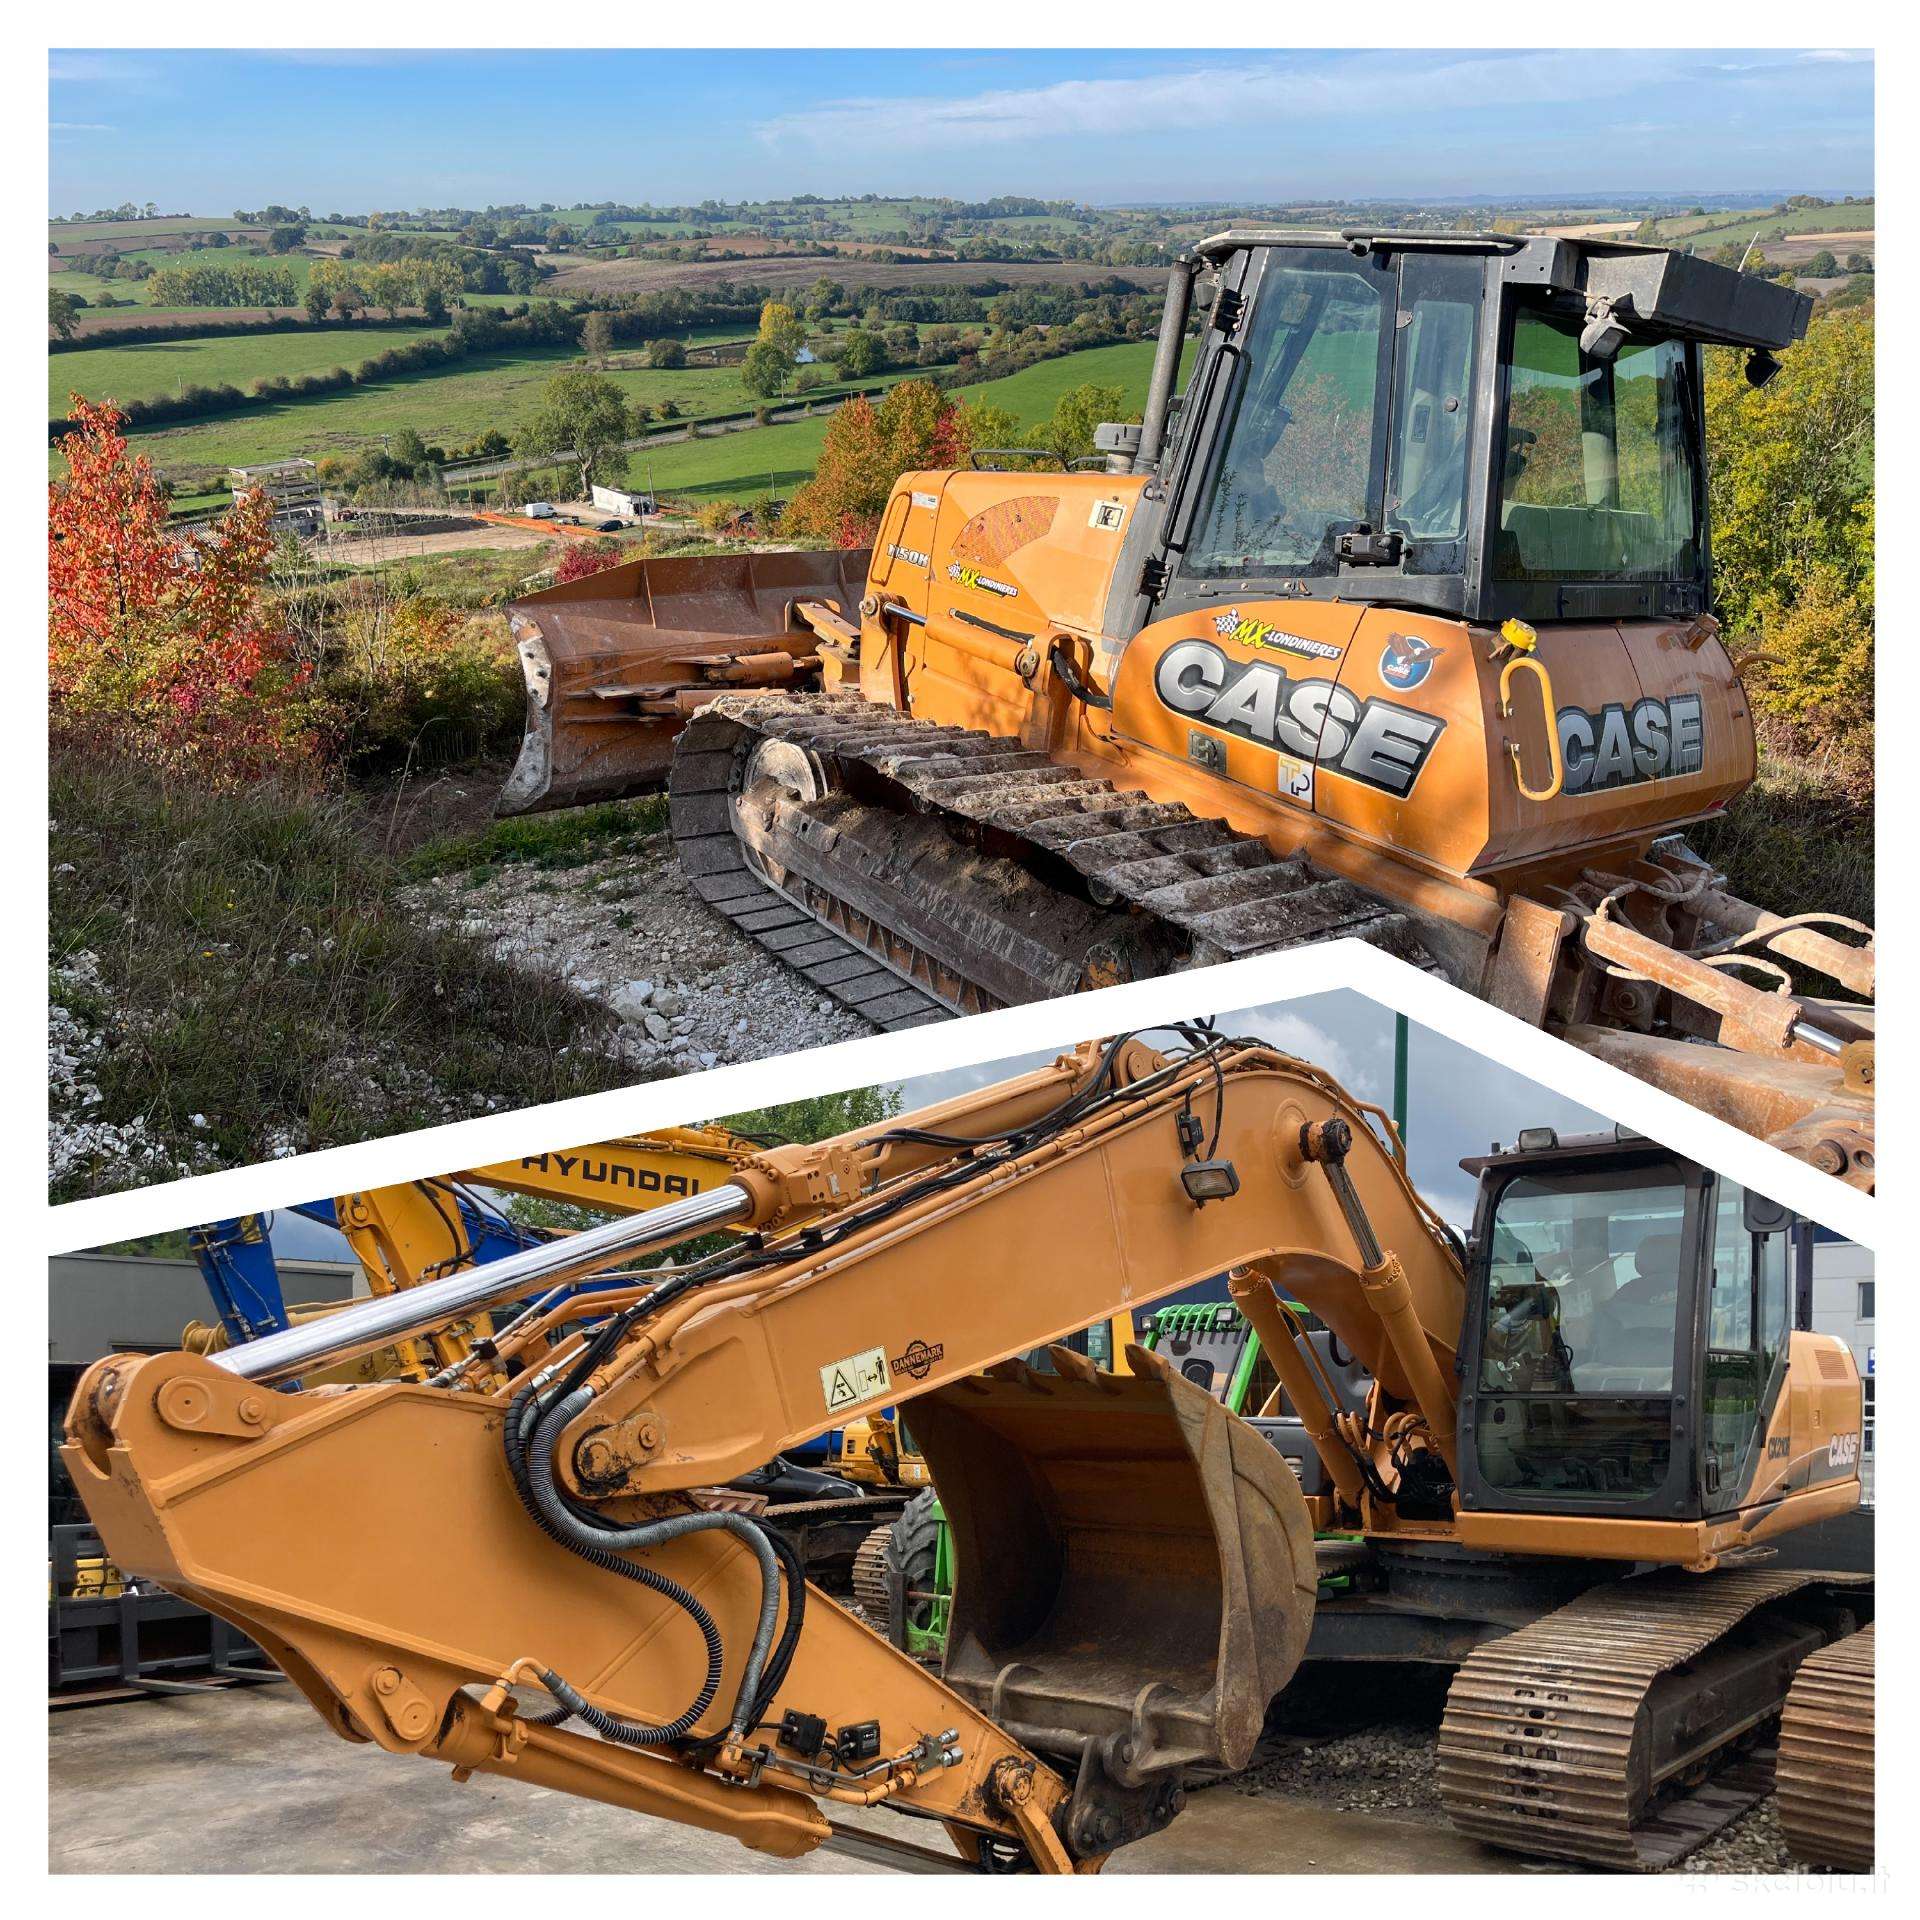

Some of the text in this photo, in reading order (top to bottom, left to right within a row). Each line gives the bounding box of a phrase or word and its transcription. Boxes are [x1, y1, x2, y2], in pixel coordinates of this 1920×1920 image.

[1157, 642, 1444, 794] CASE
[1557, 696, 1702, 791] CASE
[521, 1152, 699, 1196] HYUNDAI
[893, 1345, 943, 1371] DANNEMARK
[1829, 1433, 1858, 1467] CASE
